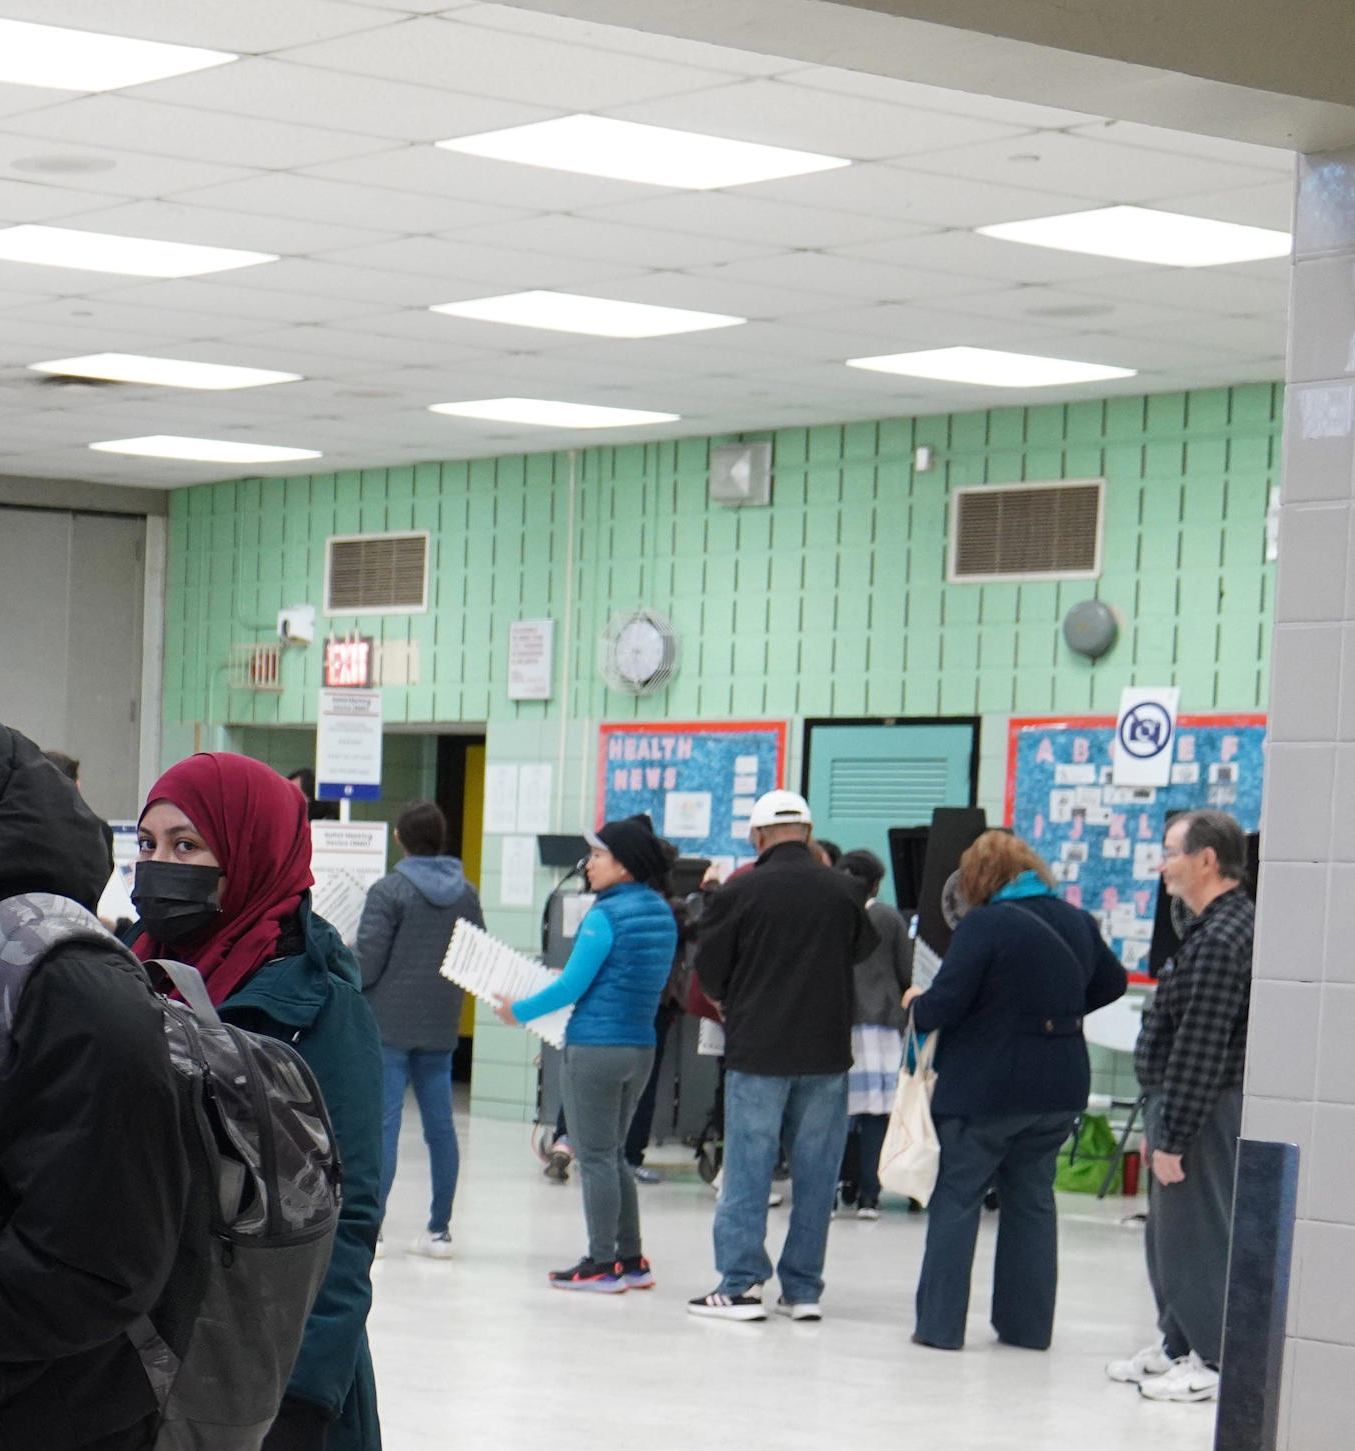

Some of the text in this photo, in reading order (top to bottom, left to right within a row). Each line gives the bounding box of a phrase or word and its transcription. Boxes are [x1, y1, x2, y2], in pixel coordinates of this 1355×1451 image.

[608, 736, 693, 761] HEALTH
[1036, 737, 1055, 763] A
[1073, 737, 1089, 763] B
[1177, 735, 1196, 761] E
[1221, 735, 1239, 762] F
[613, 766, 677, 792] NEWS
